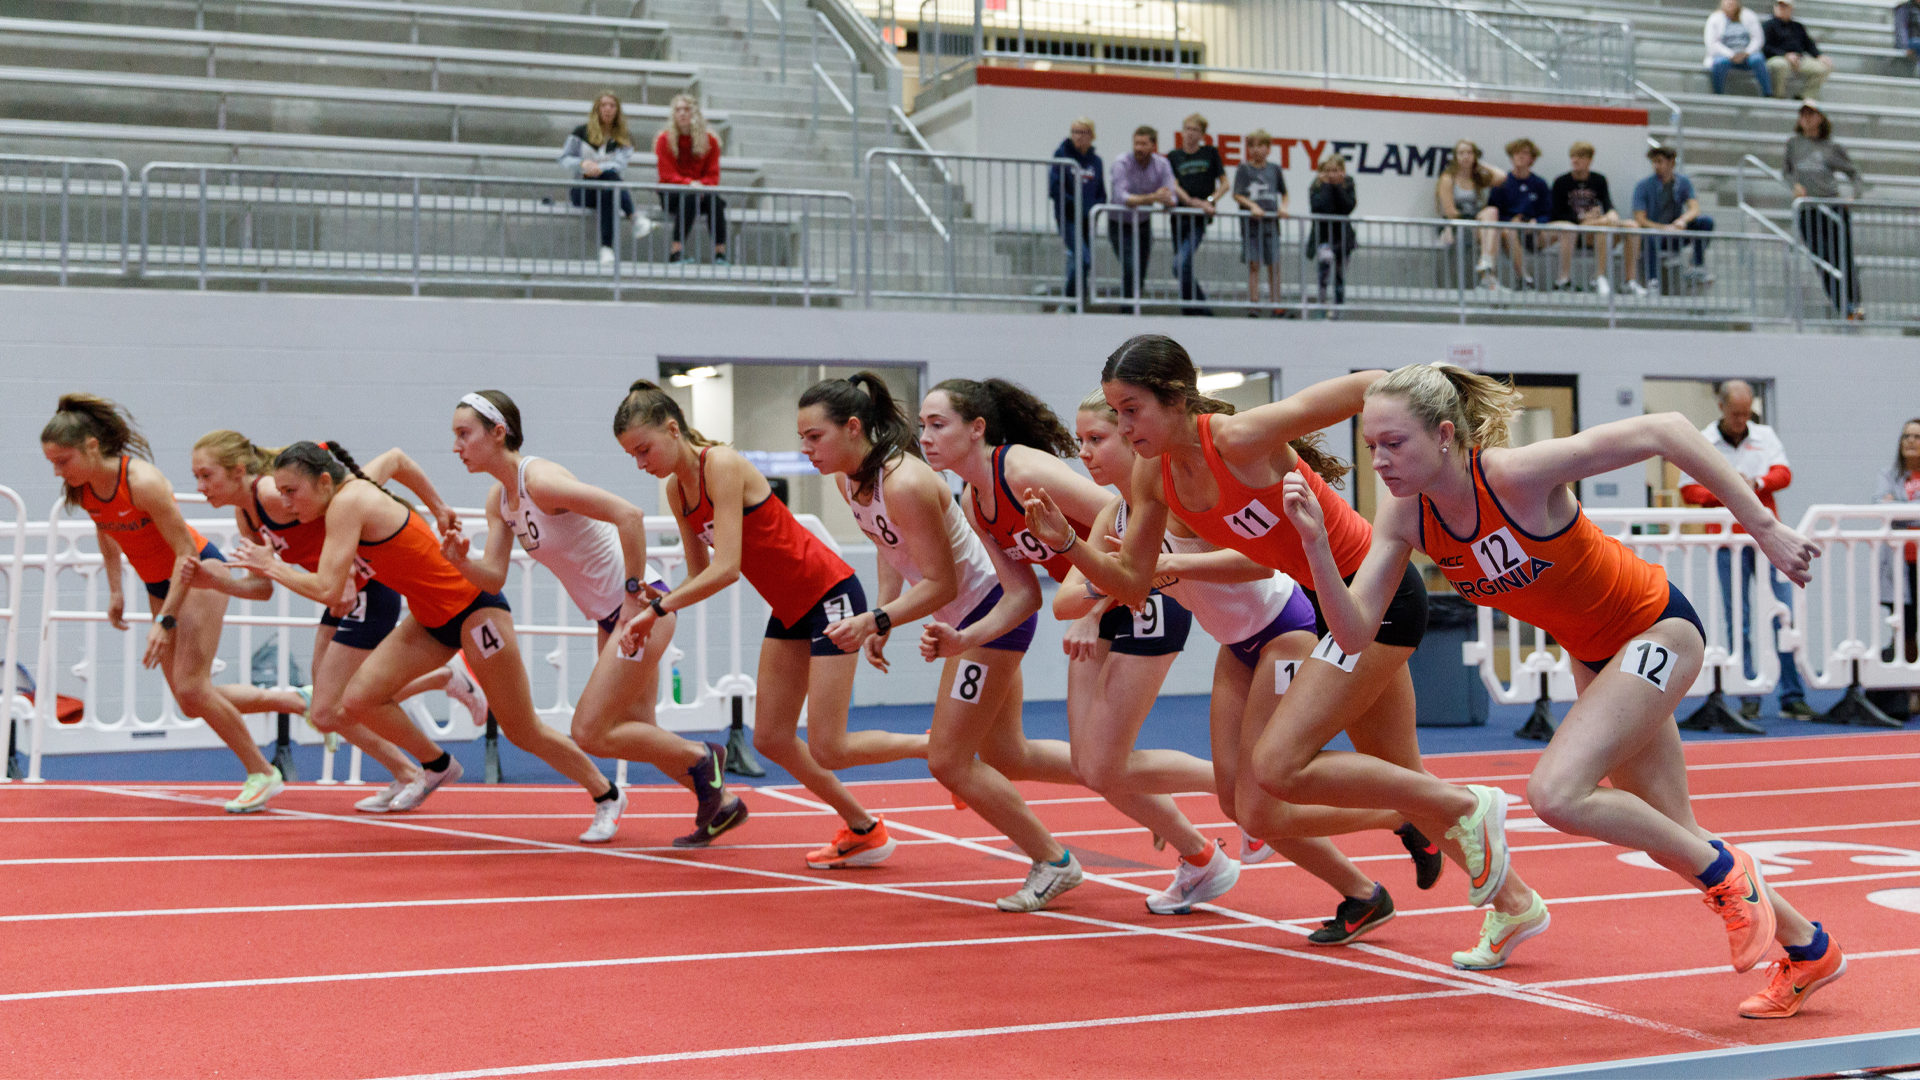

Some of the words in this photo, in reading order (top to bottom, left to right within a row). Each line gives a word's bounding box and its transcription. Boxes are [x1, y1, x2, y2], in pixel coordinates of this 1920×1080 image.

[525, 510, 539, 540] 6
[876, 514, 899, 545] 8
[1232, 507, 1271, 537] 11
[1020, 531, 1048, 560] 9
[1480, 533, 1520, 575] 12
[1438, 555, 1464, 567] ACC
[829, 597, 845, 621] 7
[1140, 597, 1158, 635] 9
[481, 624, 499, 650] 4
[1636, 642, 1668, 686] 12
[959, 664, 982, 700] 8
